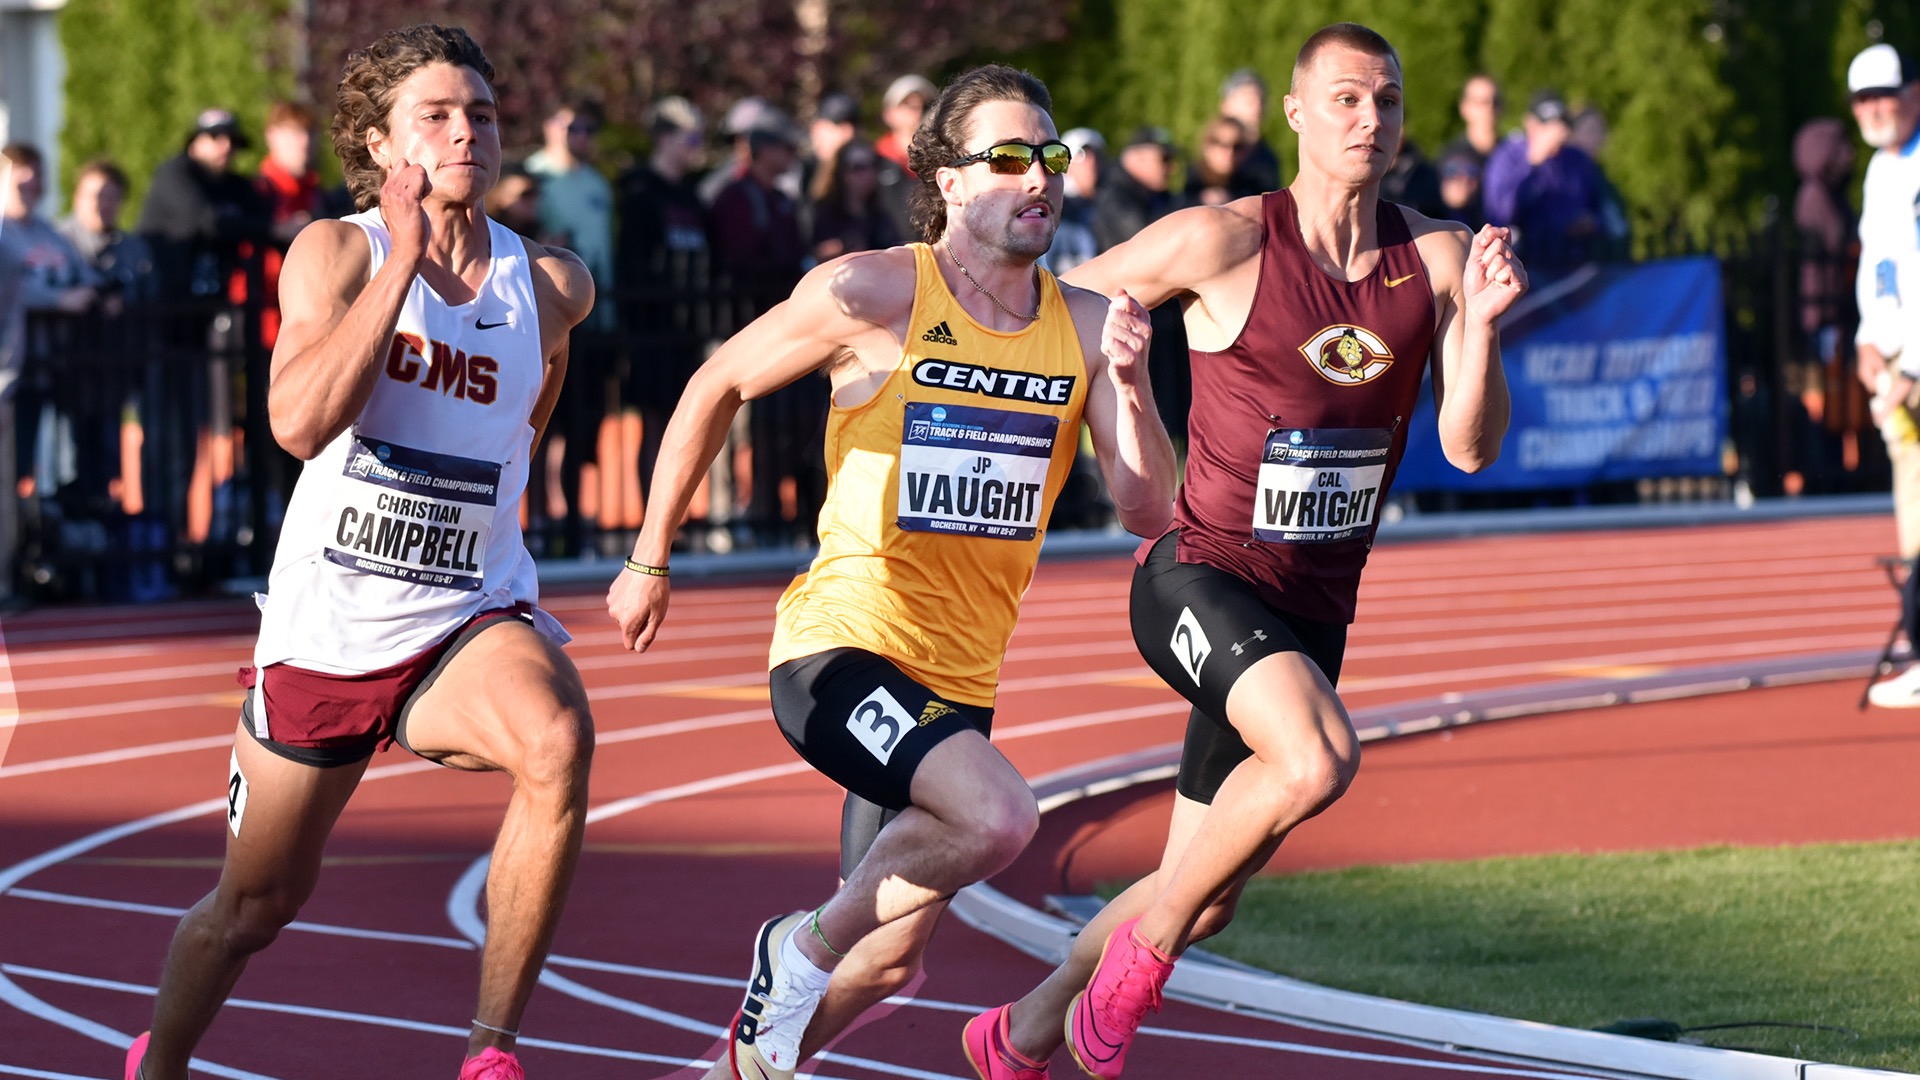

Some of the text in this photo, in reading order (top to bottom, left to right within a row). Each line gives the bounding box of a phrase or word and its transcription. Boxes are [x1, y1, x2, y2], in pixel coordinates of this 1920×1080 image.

[922, 333, 958, 346] adidas
[385, 331, 499, 405] CMS
[914, 361, 1071, 402] CENTRE
[930, 427, 958, 438] TRACK
[958, 429, 965, 439] &
[965, 430, 988, 442] FIELD
[988, 433, 1052, 448] CHAMPIONSHIPS
[1288, 448, 1313, 459] TRACK
[1313, 449, 1319, 459] &
[1319, 449, 1338, 459] FIELD
[1338, 447, 1389, 459] CHAMPIONSHIPS
[371, 464, 400, 480] TRACK
[407, 473, 432, 486] FIELD
[432, 478, 494, 495] CHAMPIONSHIPS
[972, 457, 992, 474] JP
[1318, 471, 1342, 488] CAL
[377, 493, 461, 524] CHRISTIAN
[907, 472, 1040, 522] VAUGHT
[1265, 487, 1376, 527] WRIGHT
[336, 507, 478, 572] CAMPBELL
[930, 520, 967, 532] ROCHESTER,
[968, 524, 978, 532] NY
[987, 526, 1000, 534] MAY
[355, 558, 396, 576] ROCHESTER,
[397, 568, 409, 577] NY
[419, 573, 434, 582] MAY
[1176, 623, 1203, 676] 2
[855, 700, 900, 753] 3
[229, 771, 241, 823] 4
